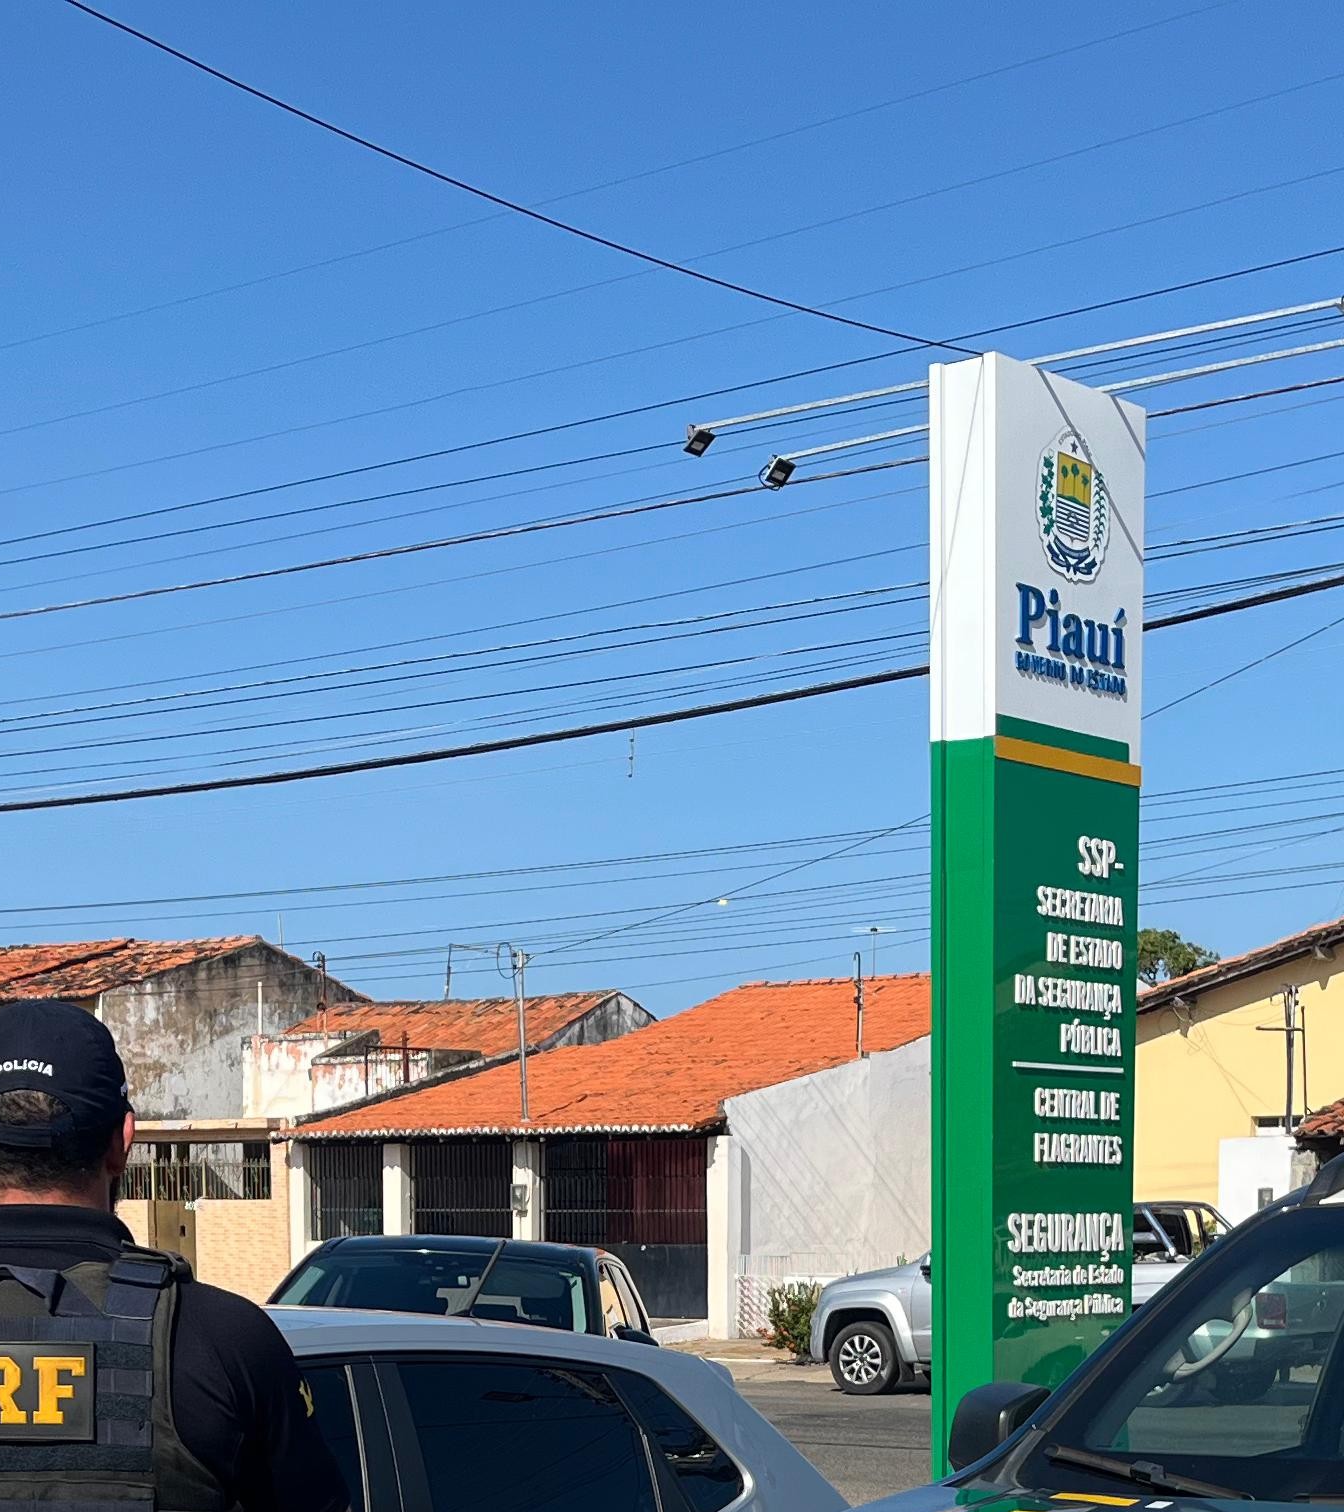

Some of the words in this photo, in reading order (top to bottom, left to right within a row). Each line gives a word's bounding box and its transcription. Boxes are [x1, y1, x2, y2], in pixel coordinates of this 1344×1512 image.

[1015, 581, 1126, 670] Piauí
[1015, 650, 1067, 681] GOVERNO
[1070, 665, 1085, 685] DO
[1087, 669, 1126, 696] ESTADO
[1036, 885, 1124, 927] SECRETARIA
[1046, 931, 1068, 963] DE
[1069, 934, 1123, 970] ESTADO
[1014, 973, 1036, 1005] DA
[1038, 976, 1123, 1020] SEGURANÇA
[1060, 1018, 1122, 1057] PÚBLICA
[1034, 1087, 1098, 1119] CENTRAL
[1100, 1091, 1120, 1121] DE
[1034, 1132, 1123, 1165] FLAGRANTES
[1007, 1212, 1125, 1262] SEGURANÇA
[1012, 1265, 1072, 1287] Secretaria
[1072, 1264, 1087, 1285] de
[1088, 1264, 1124, 1285] Estado
[1007, 1297, 1024, 1318] da
[1024, 1297, 1083, 1321] Segurança
